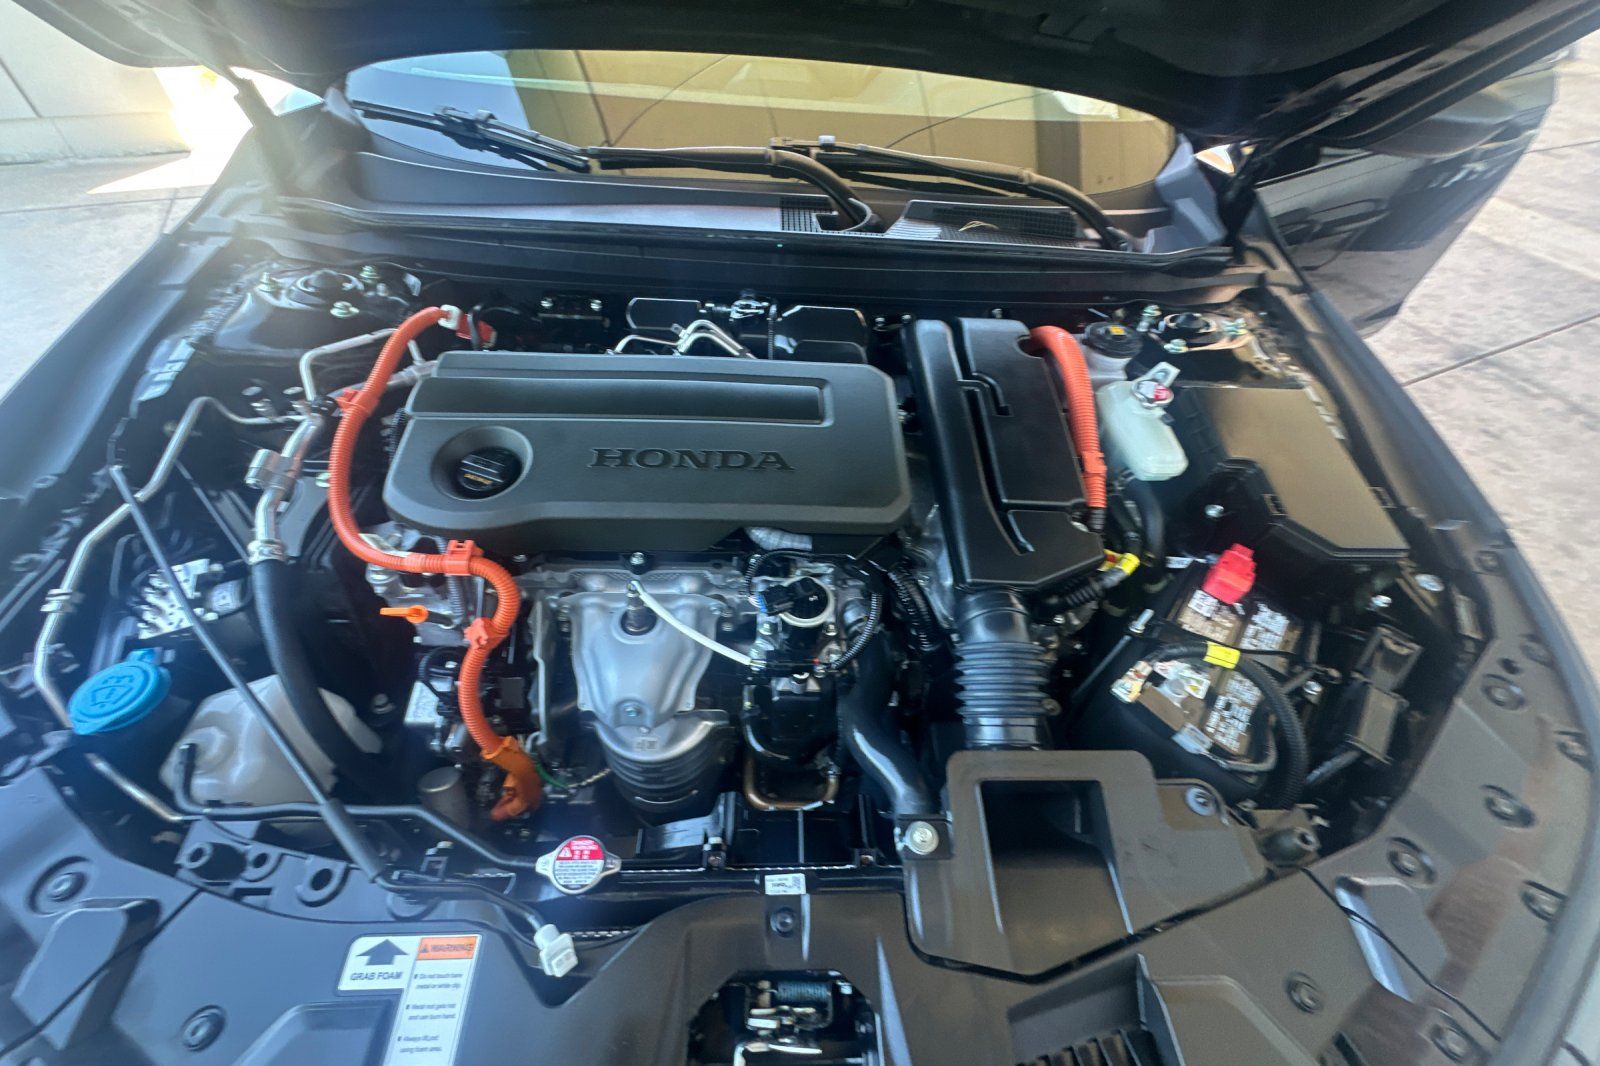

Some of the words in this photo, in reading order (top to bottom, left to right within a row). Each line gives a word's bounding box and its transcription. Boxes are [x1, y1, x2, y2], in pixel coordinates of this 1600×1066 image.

[587, 448, 795, 470] HONDA
[430, 943, 474, 953] WARNING
[350, 972, 375, 981] GRAB
[377, 971, 403, 980] FOAM
